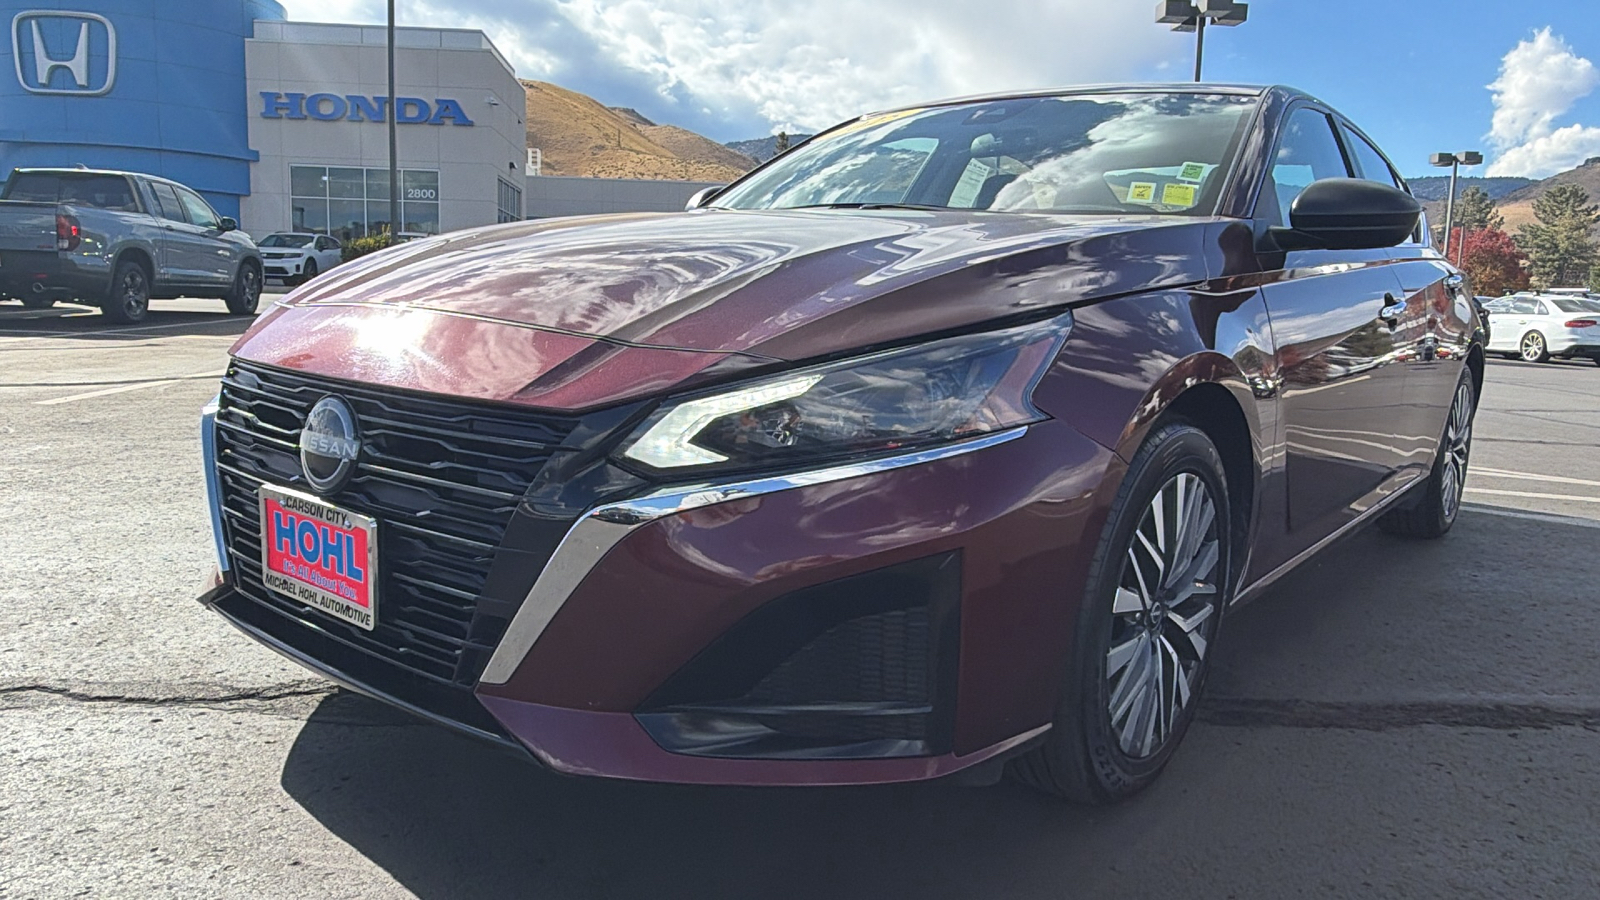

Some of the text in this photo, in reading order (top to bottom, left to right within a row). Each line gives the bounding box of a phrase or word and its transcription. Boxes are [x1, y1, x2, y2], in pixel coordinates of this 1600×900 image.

[259, 91, 475, 126] HONDA
[407, 188, 436, 199] 2800
[286, 497, 348, 526] CARSON CITY
[274, 511, 364, 583] HOHL
[283, 558, 296, 574] It's
[298, 565, 309, 579] All
[311, 570, 337, 592] About
[265, 573, 372, 627] MICHAEL HOHL AUTOMOTIVE
